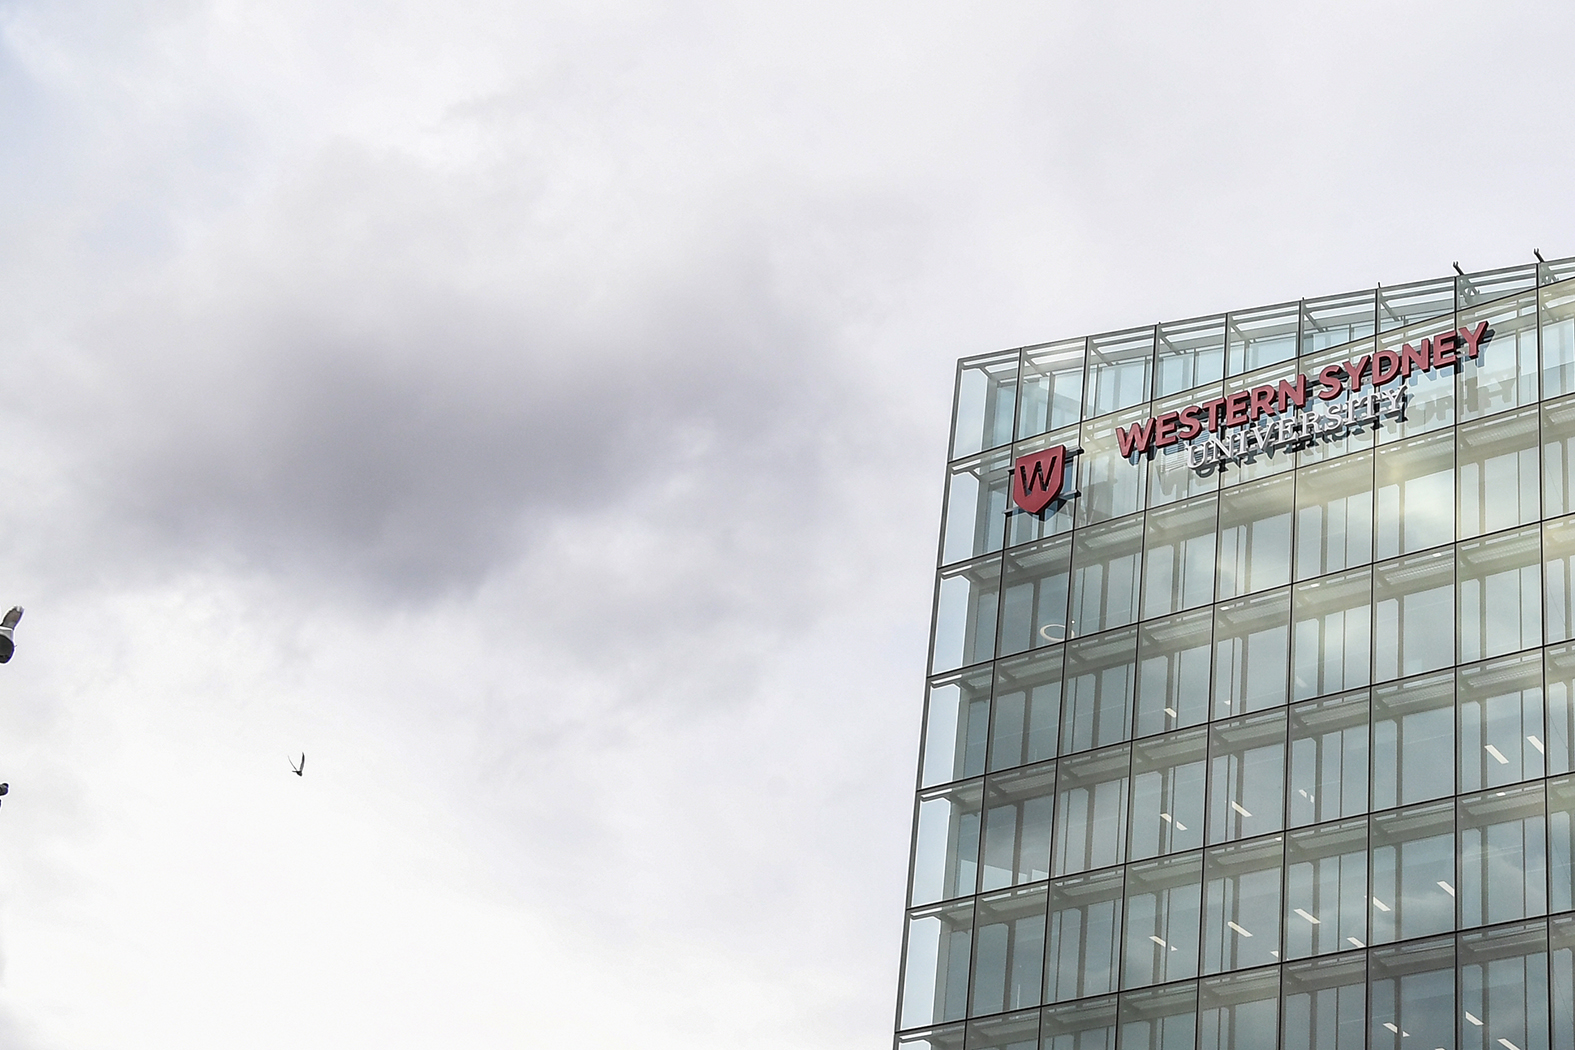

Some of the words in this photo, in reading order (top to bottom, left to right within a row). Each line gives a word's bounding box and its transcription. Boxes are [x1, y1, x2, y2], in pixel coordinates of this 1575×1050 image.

[1115, 373, 1308, 459] WESTERN
[1318, 321, 1491, 400] SYDNEY
[1185, 385, 1408, 470] UNIVERSITY
